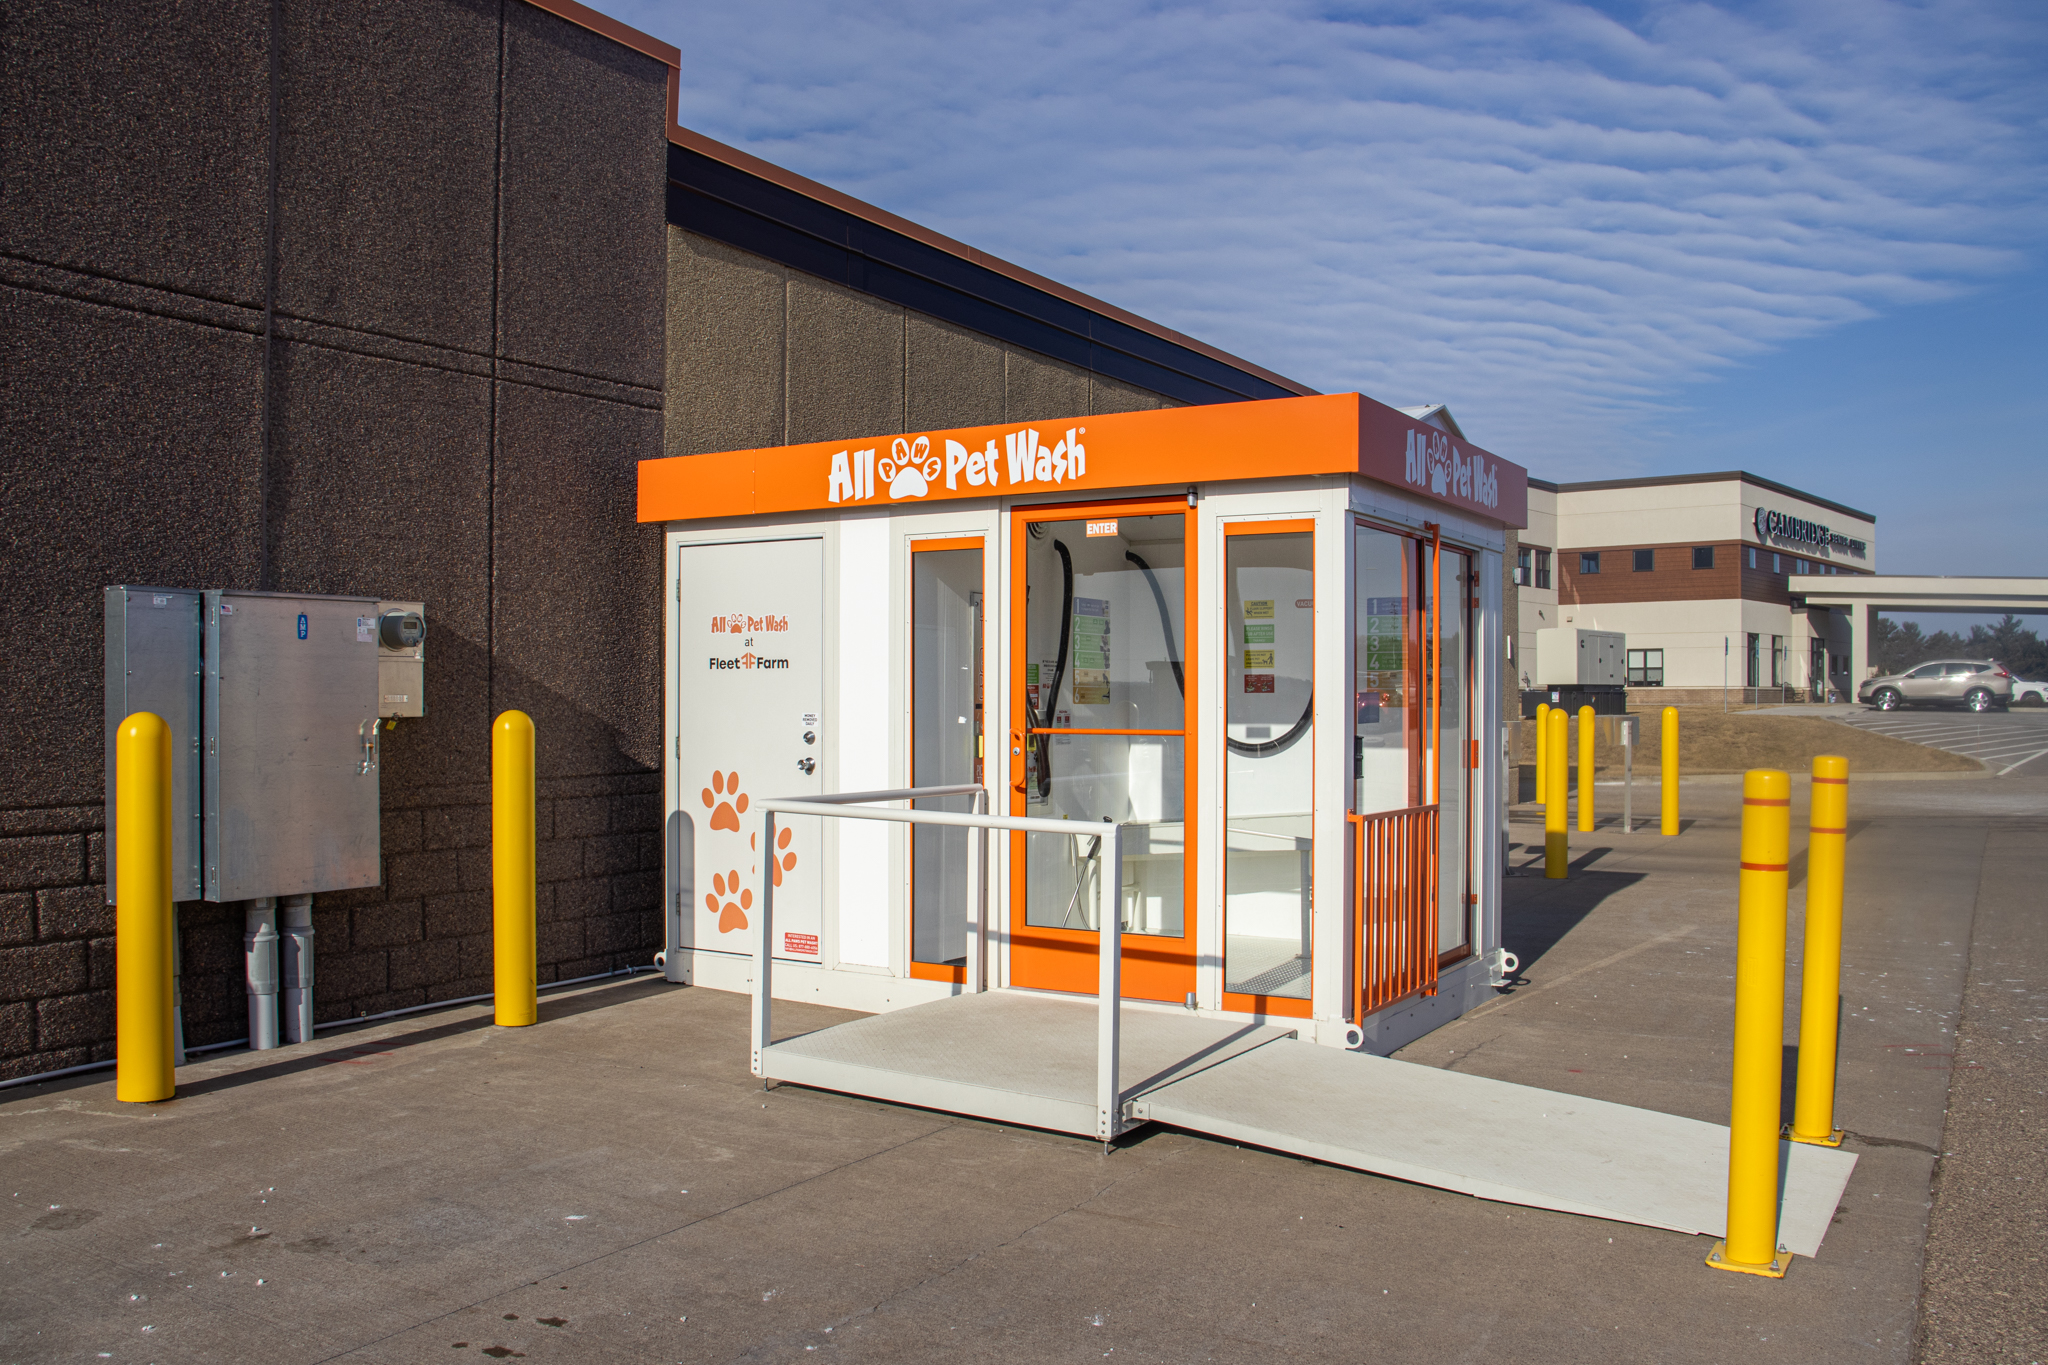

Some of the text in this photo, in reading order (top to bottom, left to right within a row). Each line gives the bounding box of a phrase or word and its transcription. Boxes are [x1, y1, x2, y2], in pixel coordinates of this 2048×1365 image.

[828, 448, 875, 503] All
[881, 441, 939, 480] PAWS
[945, 439, 999, 491] Pet
[1405, 428, 1427, 487] All
[1452, 445, 1472, 500] Pet
[1473, 455, 1498, 509] Wash
[1086, 522, 1117, 535] ENTER
[1768, 510, 1829, 547] CAMBRIDGE
[1371, 598, 1378, 615] 1
[299, 617, 307, 638] AMP
[711, 616, 726, 633] All
[747, 615, 763, 632] Pet
[765, 614, 788, 632] Wash
[1075, 616, 1080, 632] 2
[1370, 617, 1380, 634] 2
[744, 637, 754, 647] at
[1075, 634, 1080, 650] 3
[1370, 635, 1380, 651] 3
[709, 656, 789, 670] Fleet Farm
[1075, 652, 1080, 668] 4
[1370, 653, 1380, 670] 4
[1075, 669, 1080, 685] 5
[1370, 672, 1380, 688] 5
[1075, 687, 1080, 703] 6
